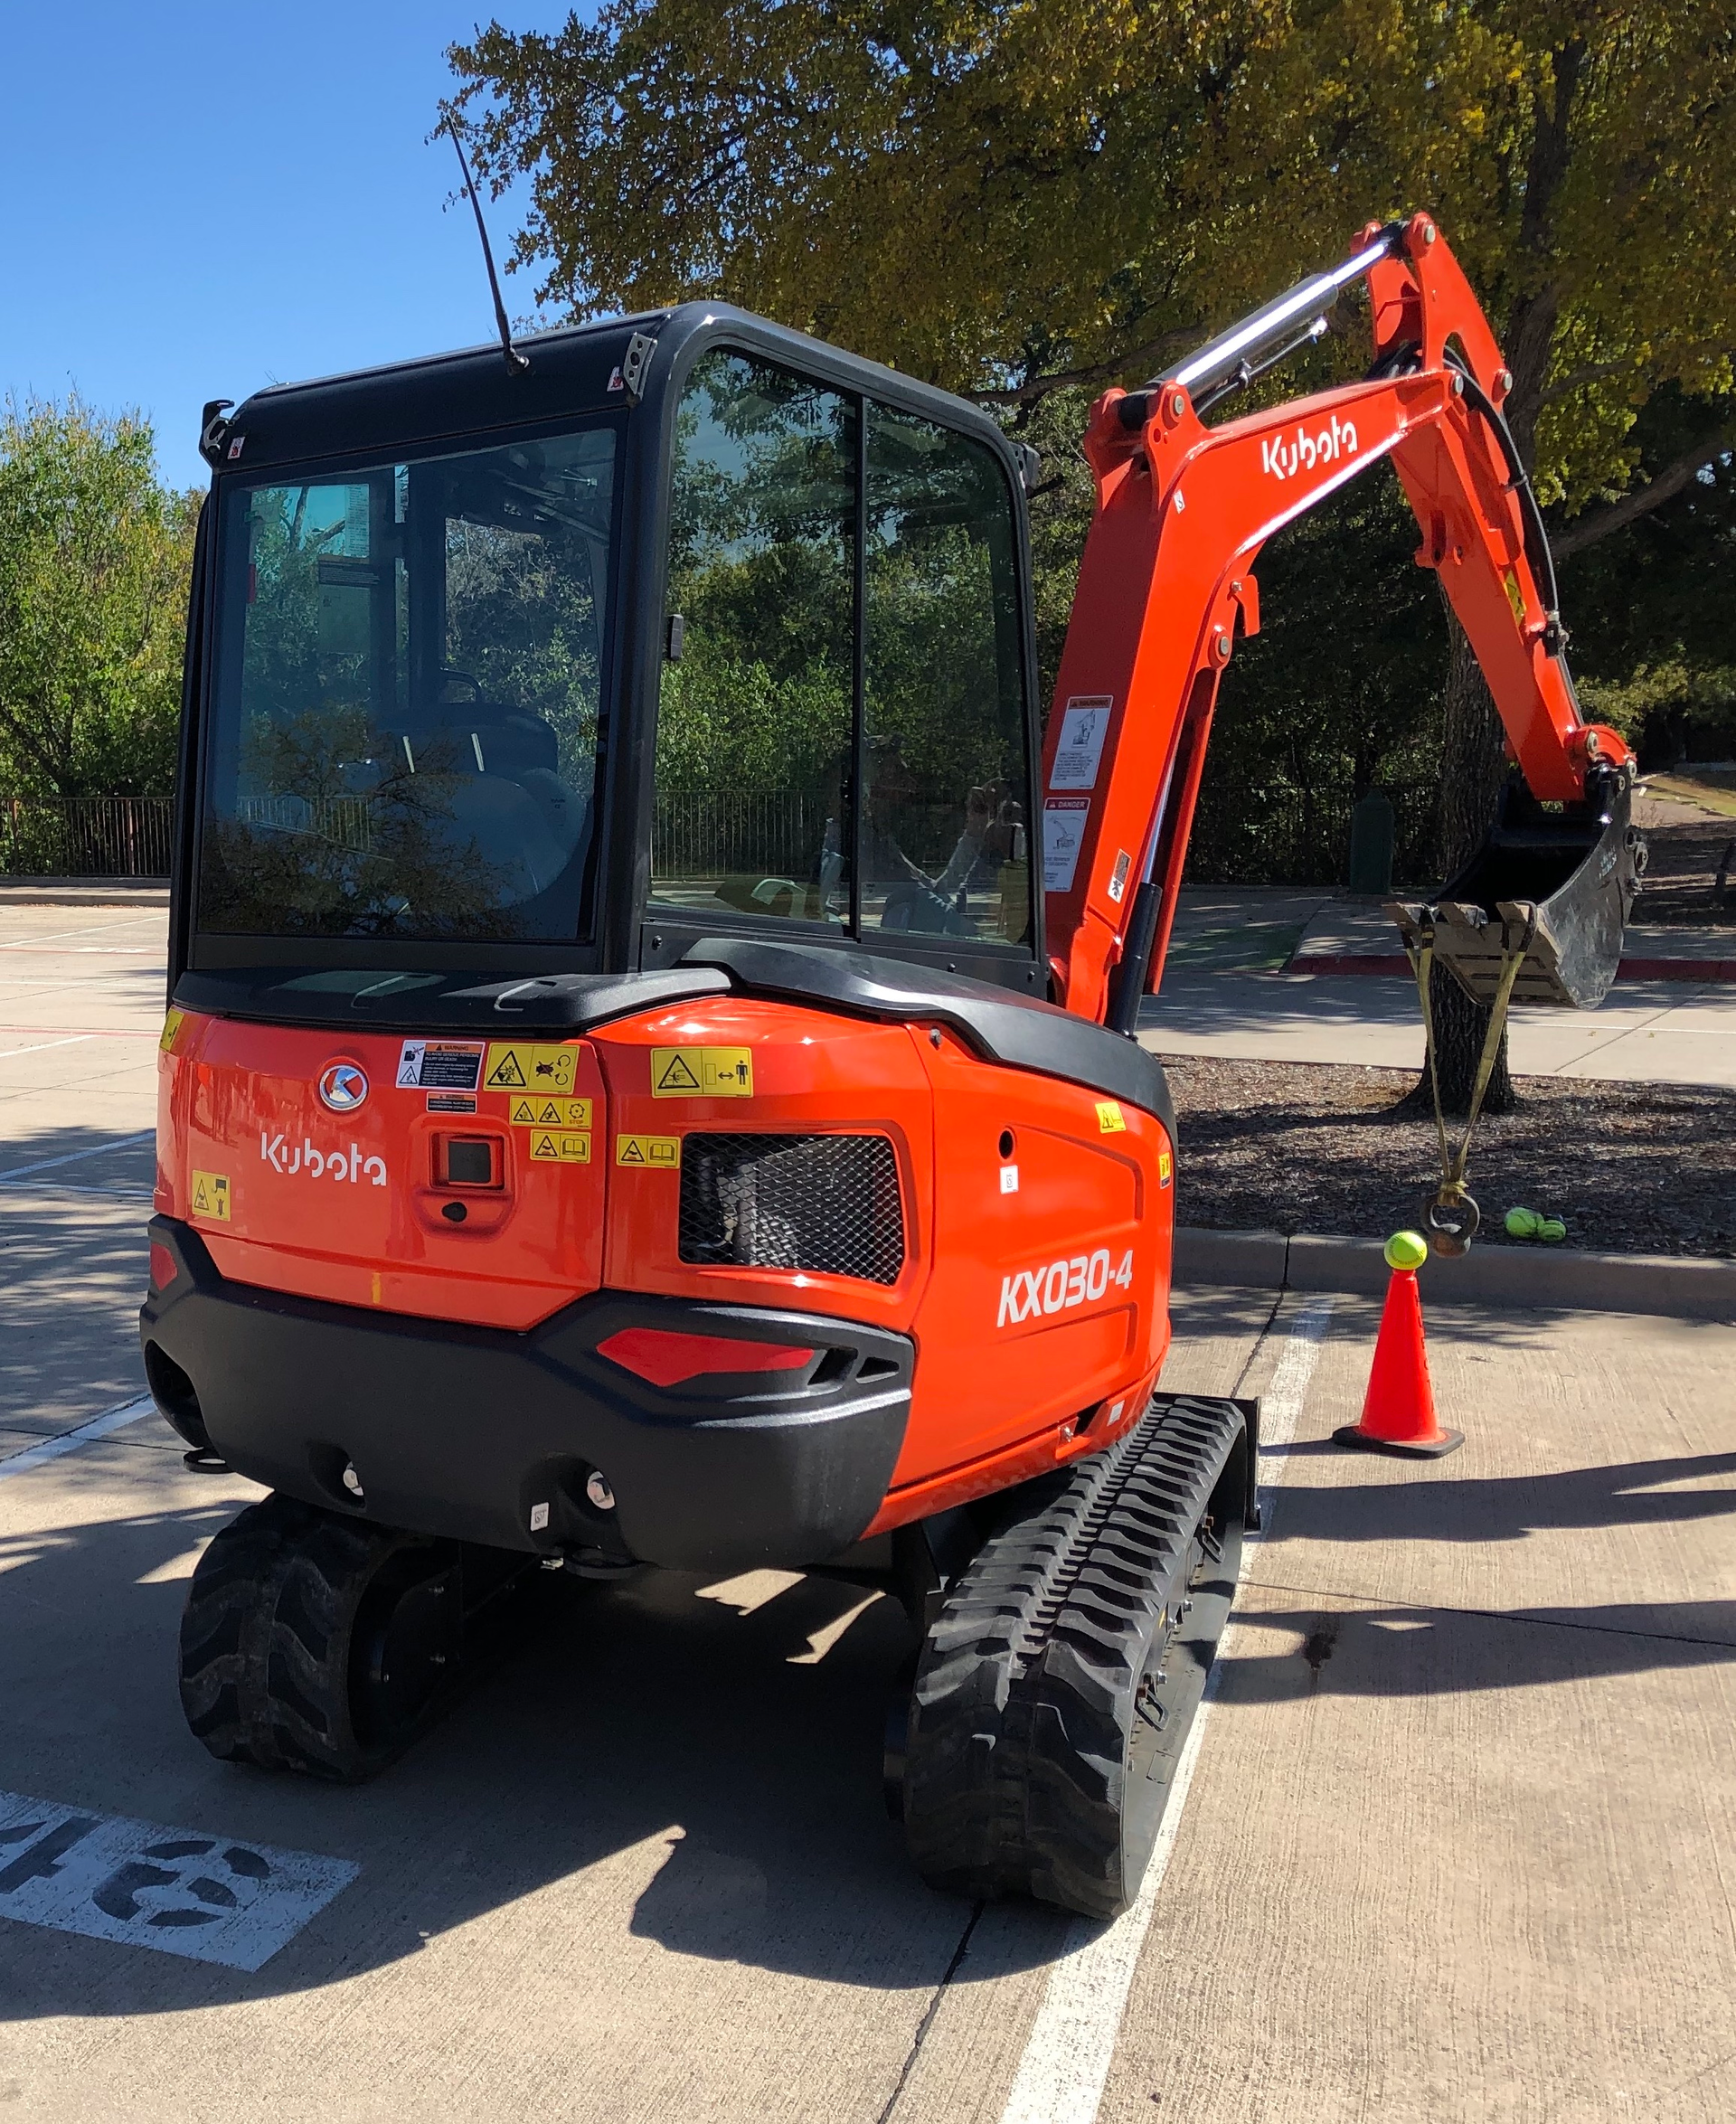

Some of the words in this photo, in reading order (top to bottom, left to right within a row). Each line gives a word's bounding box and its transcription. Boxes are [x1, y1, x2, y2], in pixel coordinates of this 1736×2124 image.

[1261, 415, 1358, 480] Kubota
[260, 1131, 387, 1186] Kubota
[996, 1249, 1133, 1328] KX030-4
